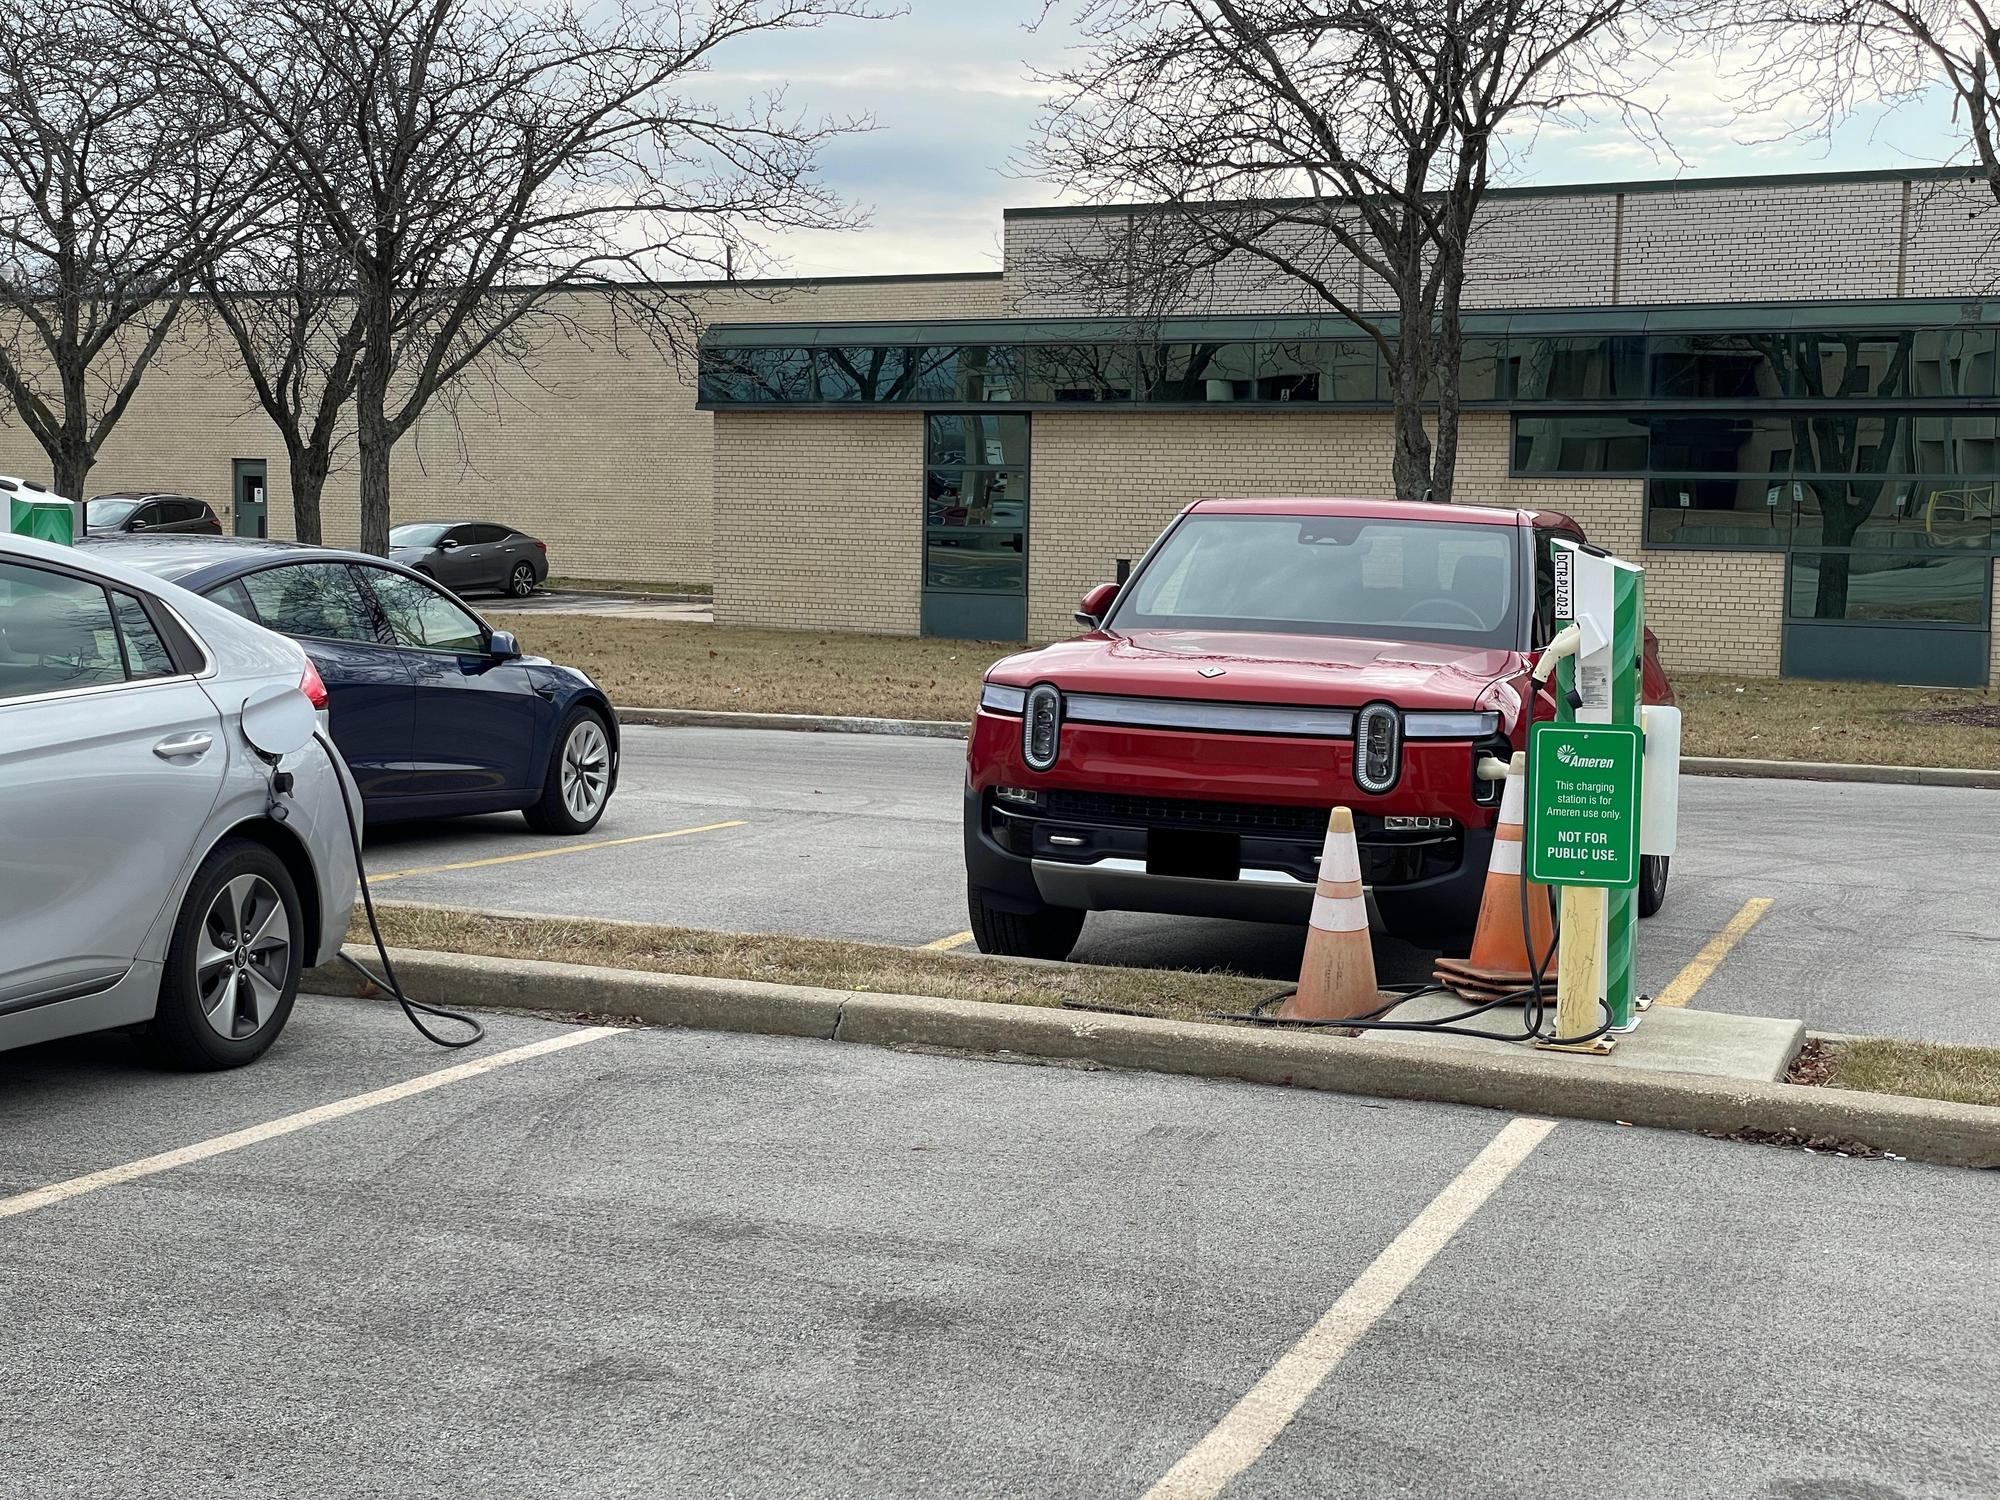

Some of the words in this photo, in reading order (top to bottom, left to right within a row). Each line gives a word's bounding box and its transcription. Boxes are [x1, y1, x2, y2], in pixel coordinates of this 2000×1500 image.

[1557, 554, 1568, 616] DCTR-PLZ-02-R
[1570, 755, 1614, 768] Ameren
[1556, 780, 1574, 790] This
[1576, 782, 1614, 793] charging
[1558, 795, 1586, 804] station
[1590, 796, 1596, 804] is
[1600, 796, 1612, 805] for
[1547, 807, 1580, 816] Ameren
[1583, 810, 1598, 818] use
[1602, 809, 1621, 820] only.
[1558, 832, 1581, 843] NOT
[1585, 833, 1607, 844] FOR
[1548, 847, 1588, 859] PUBLIC
[1592, 849, 1618, 860] USE.
